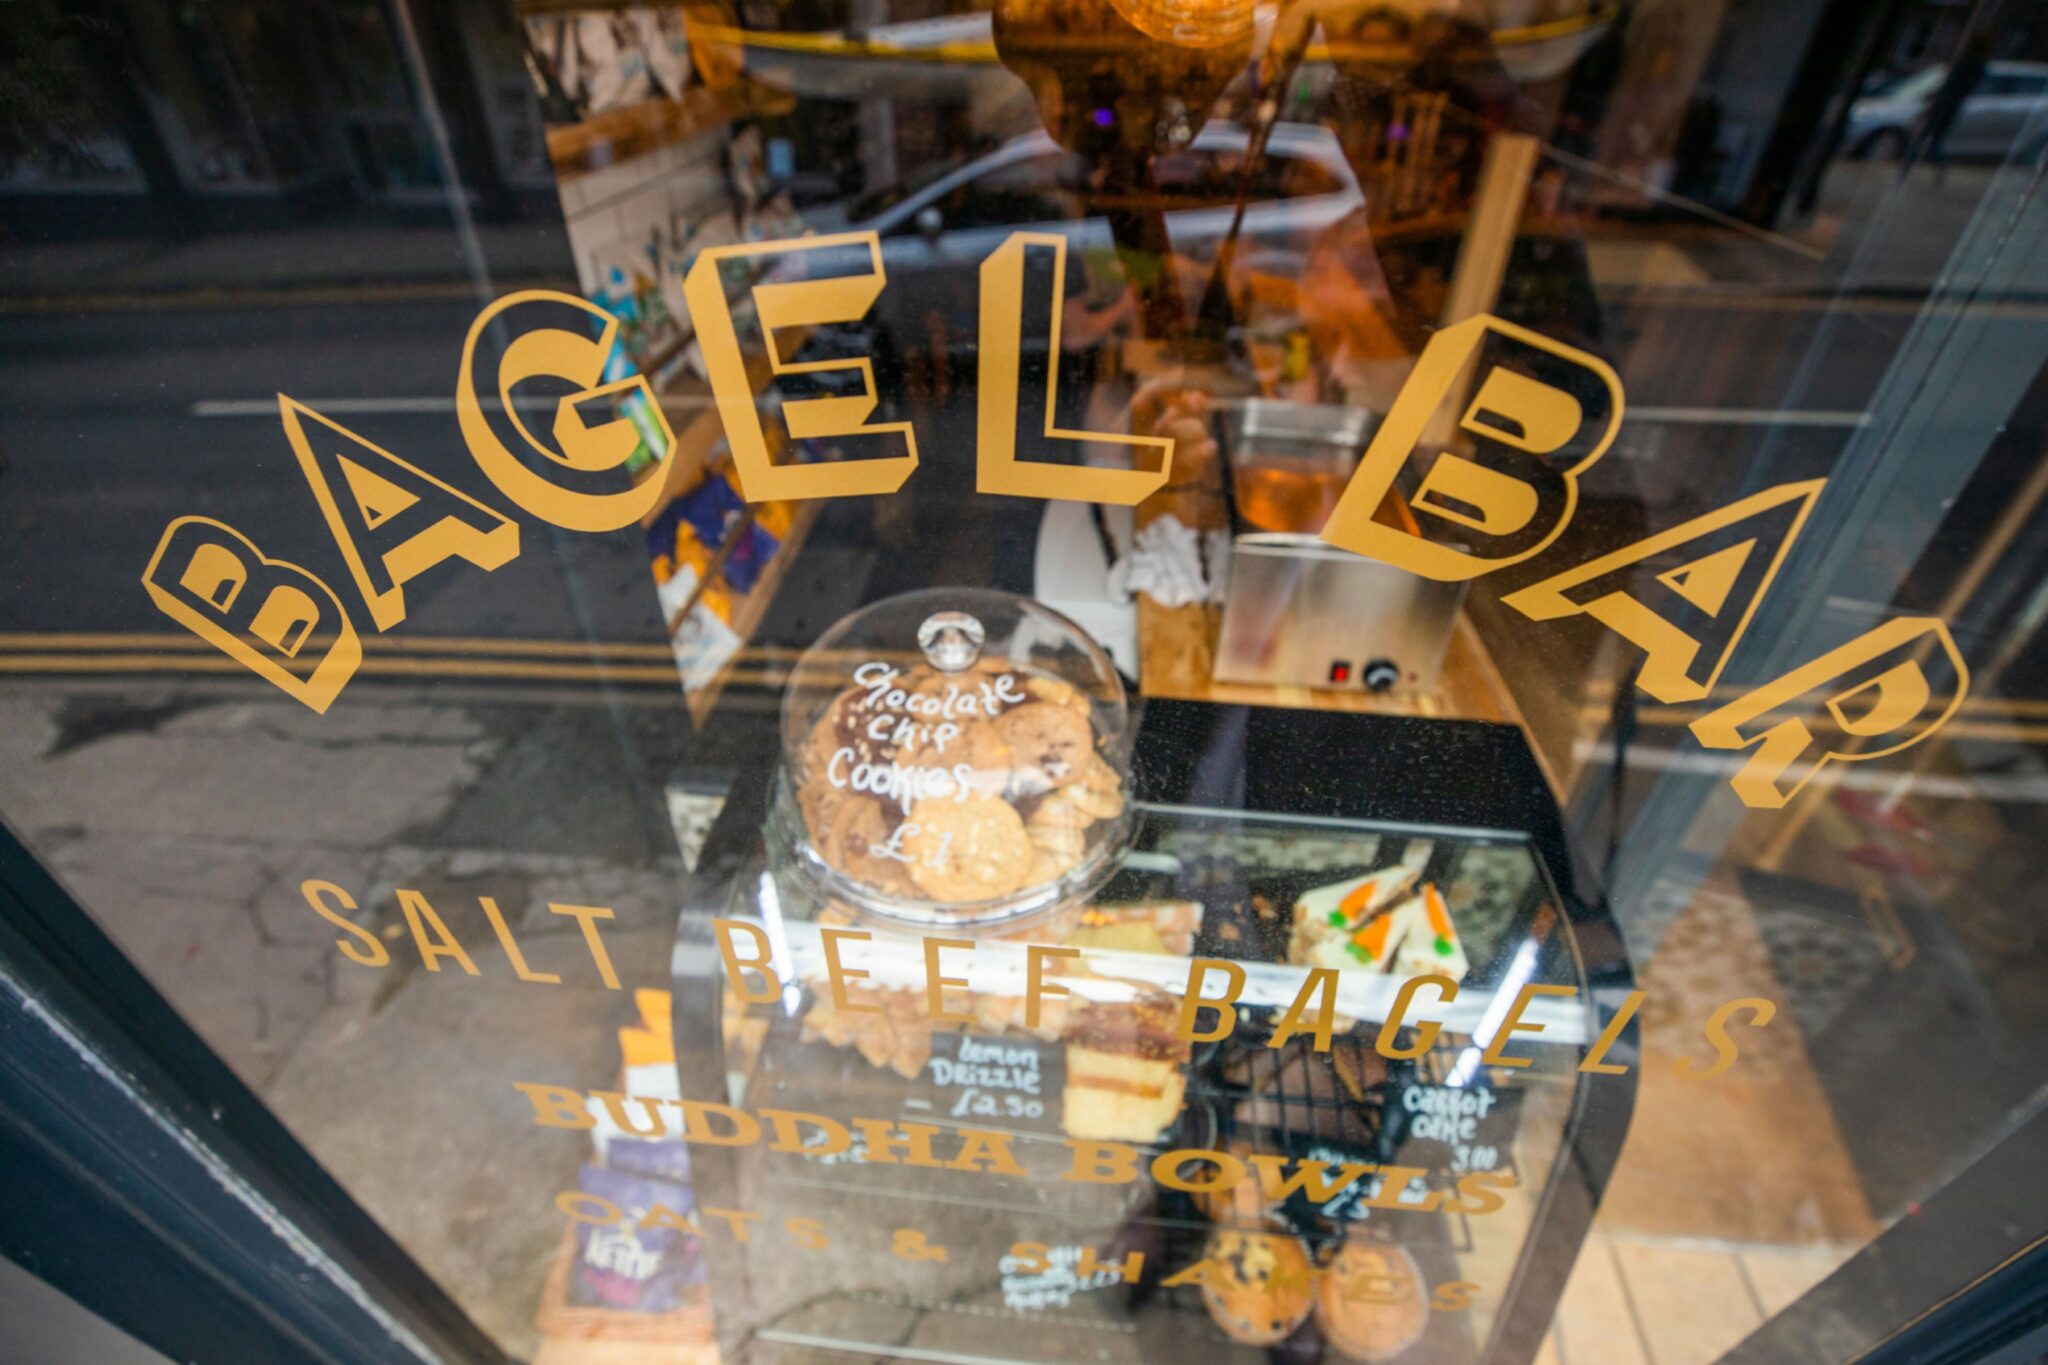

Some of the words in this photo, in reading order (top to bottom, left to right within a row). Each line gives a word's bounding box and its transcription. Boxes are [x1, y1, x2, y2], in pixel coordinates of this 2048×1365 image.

[141, 230, 1175, 715] BAGEL
[1319, 313, 1969, 809] BAR
[854, 662, 1026, 717] Chocolate
[827, 747, 974, 816] Cookies
[301, 879, 622, 990] SALT
[712, 918, 1081, 1028] BEEF
[1176, 958, 1776, 1081] BAGELS
[513, 1081, 1029, 1177] BUDDHA
[1061, 1138, 1519, 1216] BOWLS
[555, 1191, 829, 1250] OATS
[891, 1228, 948, 1263] &
[1007, 1242, 1482, 1313] SHAKES
